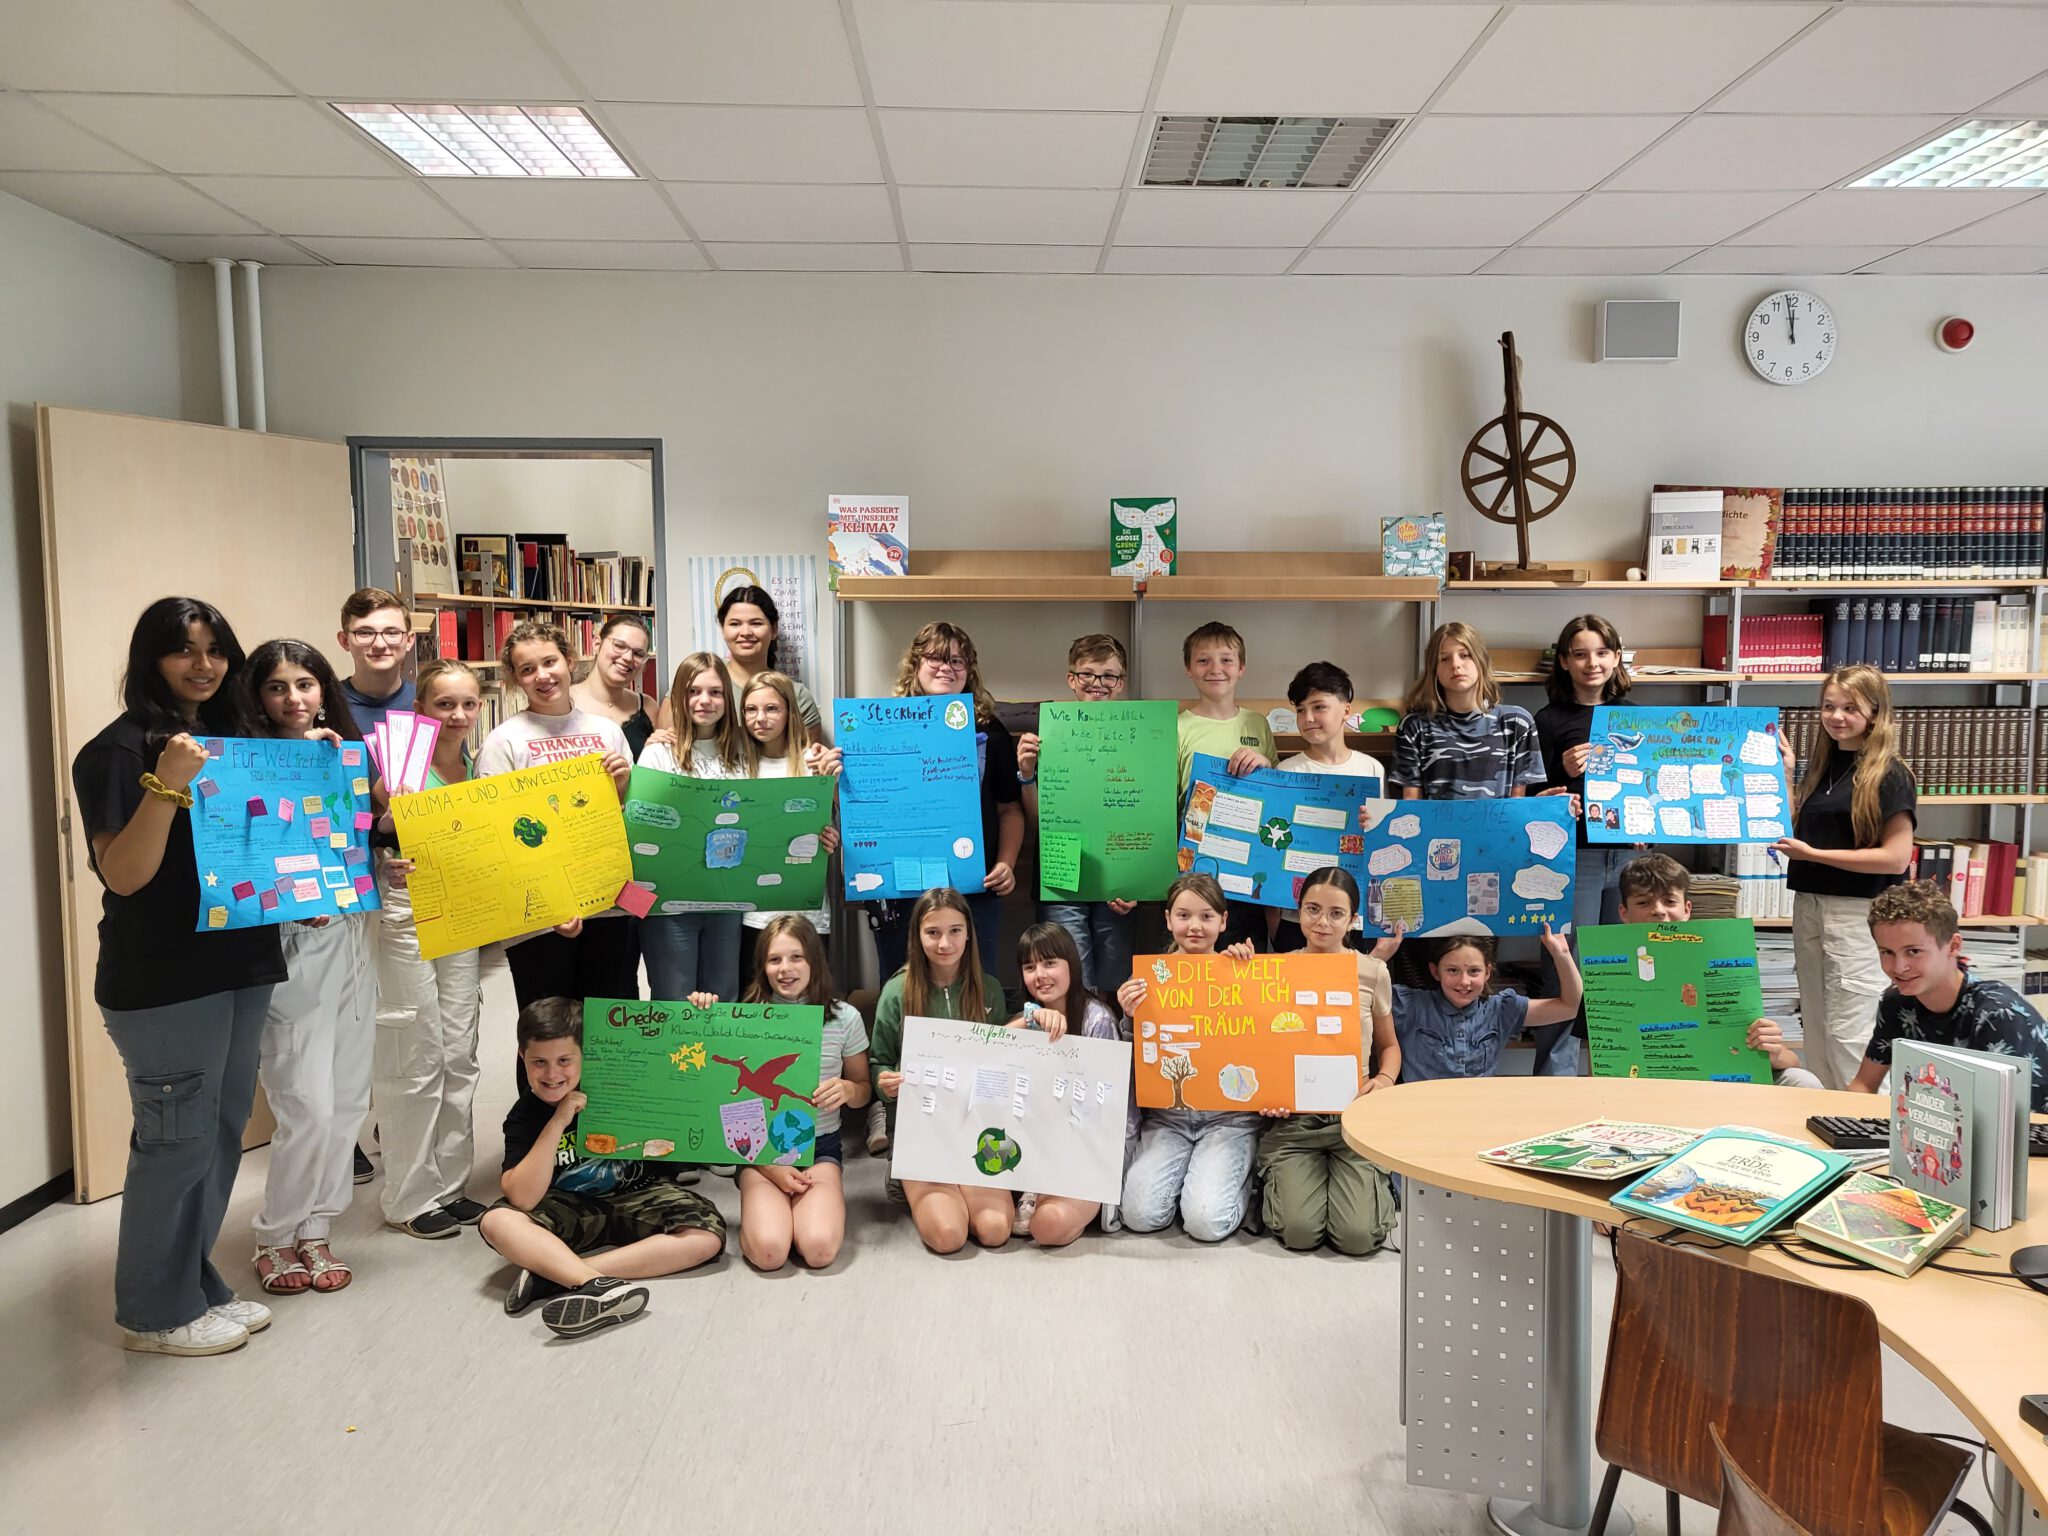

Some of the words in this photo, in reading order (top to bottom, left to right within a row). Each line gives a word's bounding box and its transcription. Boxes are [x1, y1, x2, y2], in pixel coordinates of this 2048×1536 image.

[1772, 302, 1780, 312] 11
[1807, 302, 1812, 312] 1
[1760, 314, 1770, 325] 10
[1817, 314, 1825, 325] 2
[1752, 332, 1760, 342] 9
[1822, 333, 1830, 343] 3
[1757, 350, 1764, 360] 8
[1816, 351, 1822, 360] 4
[1769, 362, 1776, 372] 7
[1785, 366, 1792, 377] 6
[1802, 363, 1809, 373] 5
[843, 523, 896, 533] KLIMA?
[867, 702, 936, 721] Steckbrief
[1050, 708, 1071, 721] Wie
[528, 736, 606, 757] STRANGER
[467, 784, 499, 803] UND
[509, 758, 607, 793] UMWELTSCHUTZ
[1177, 960, 1216, 984] DIE
[1232, 958, 1287, 983] WELT,
[1156, 987, 1194, 1009] VON
[1208, 984, 1244, 1008] DER
[1261, 982, 1290, 1004] ICH
[1190, 1012, 1256, 1037] TRÄUM
[970, 1023, 1017, 1045] Unfollow
[1916, 1092, 1946, 1111] KINDER
[1908, 1107, 1955, 1132] VERÄNDERN
[1913, 1127, 1927, 1140] DIE
[1929, 1132, 1950, 1147] WELT
